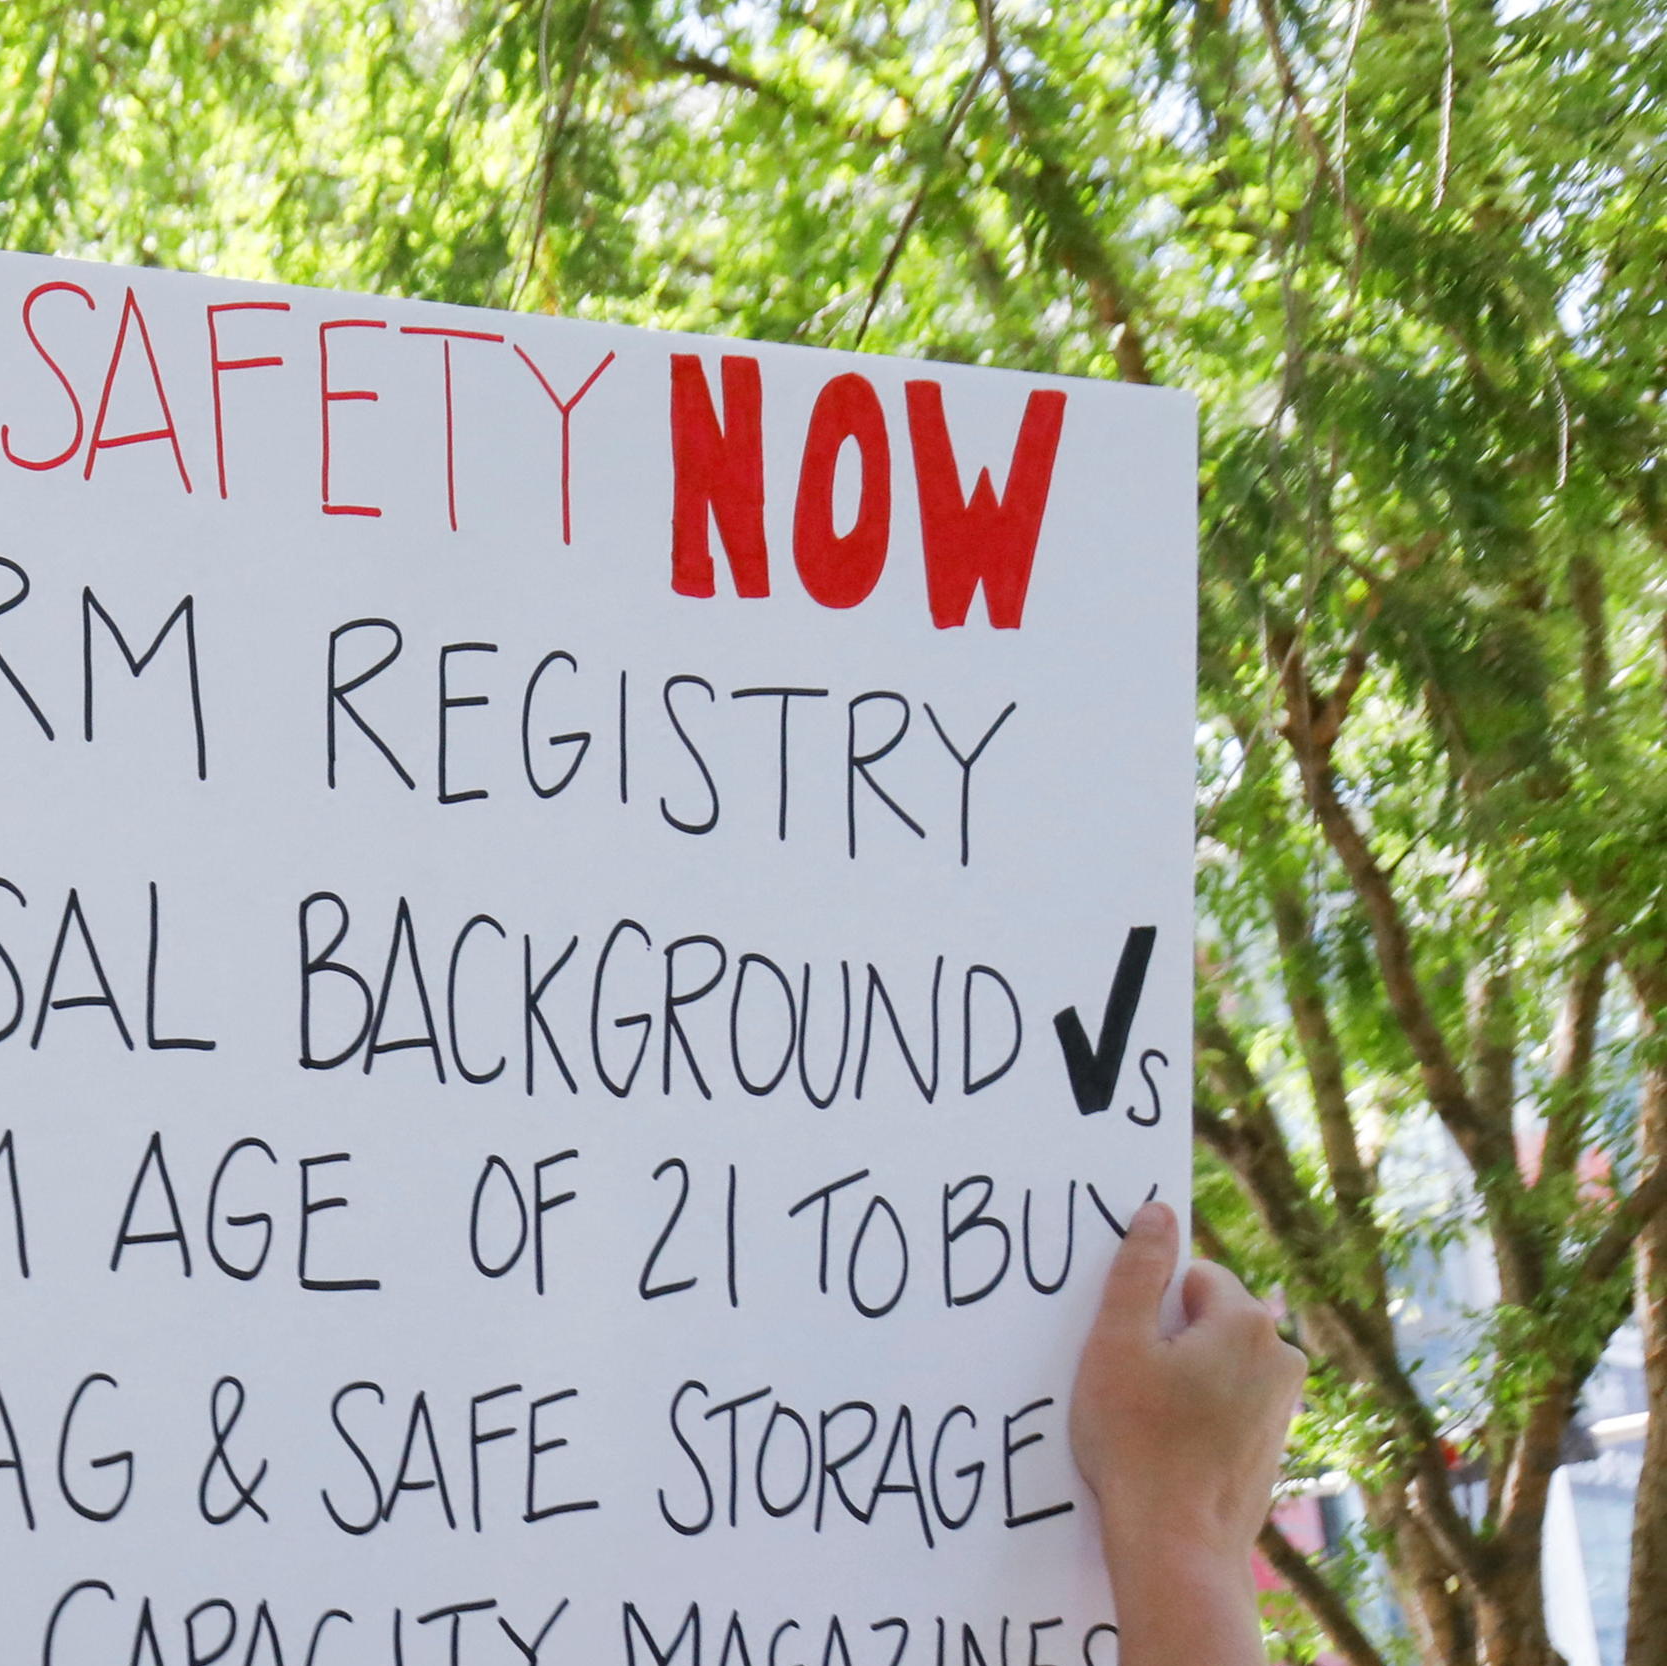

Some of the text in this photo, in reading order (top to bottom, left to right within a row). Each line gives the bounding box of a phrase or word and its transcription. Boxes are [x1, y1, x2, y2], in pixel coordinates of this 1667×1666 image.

[1, 281, 616, 544] SAFETY
[670, 353, 1068, 630] NOW
[327, 618, 1017, 867] REGISTRY
[298, 891, 1022, 1110] BACKGROUND
[110, 1131, 381, 1292] AGE
[470, 1149, 579, 1296] OF
[639, 1157, 738, 1308] 21
[788, 1168, 910, 1319] TO
[199, 1375, 269, 1525] &
[321, 1381, 600, 1537] SAFE
[658, 1380, 1075, 1549] STORAGE
